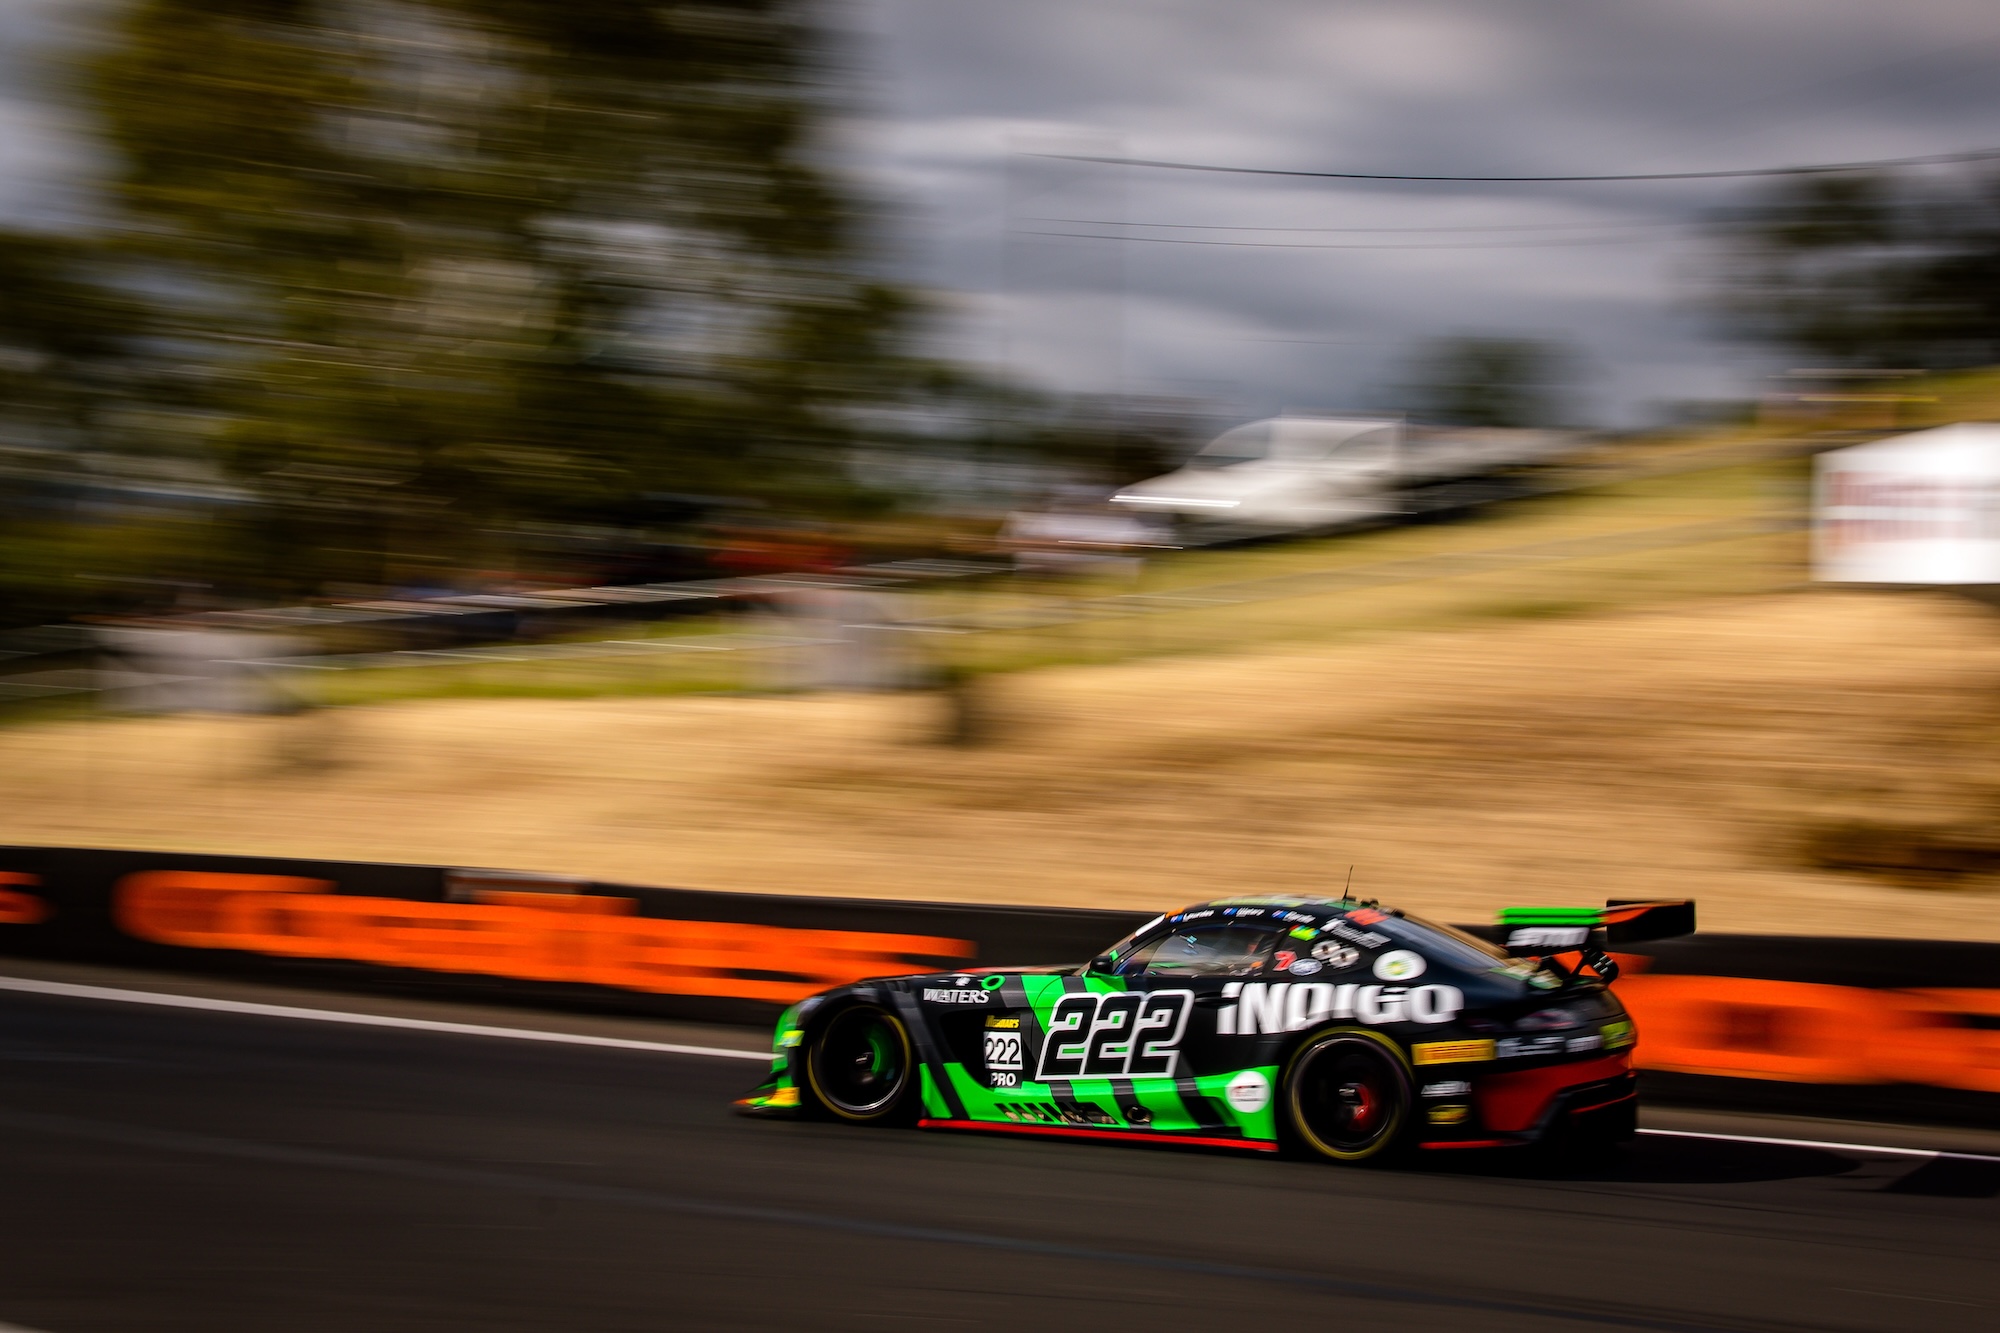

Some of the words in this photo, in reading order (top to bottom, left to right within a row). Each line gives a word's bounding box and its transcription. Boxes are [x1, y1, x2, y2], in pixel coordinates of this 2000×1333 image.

[923, 987, 991, 1004] WATERS
[1034, 988, 1196, 1081] 222
[984, 1037, 1021, 1066] 222
[990, 1072, 1017, 1087] PRO
